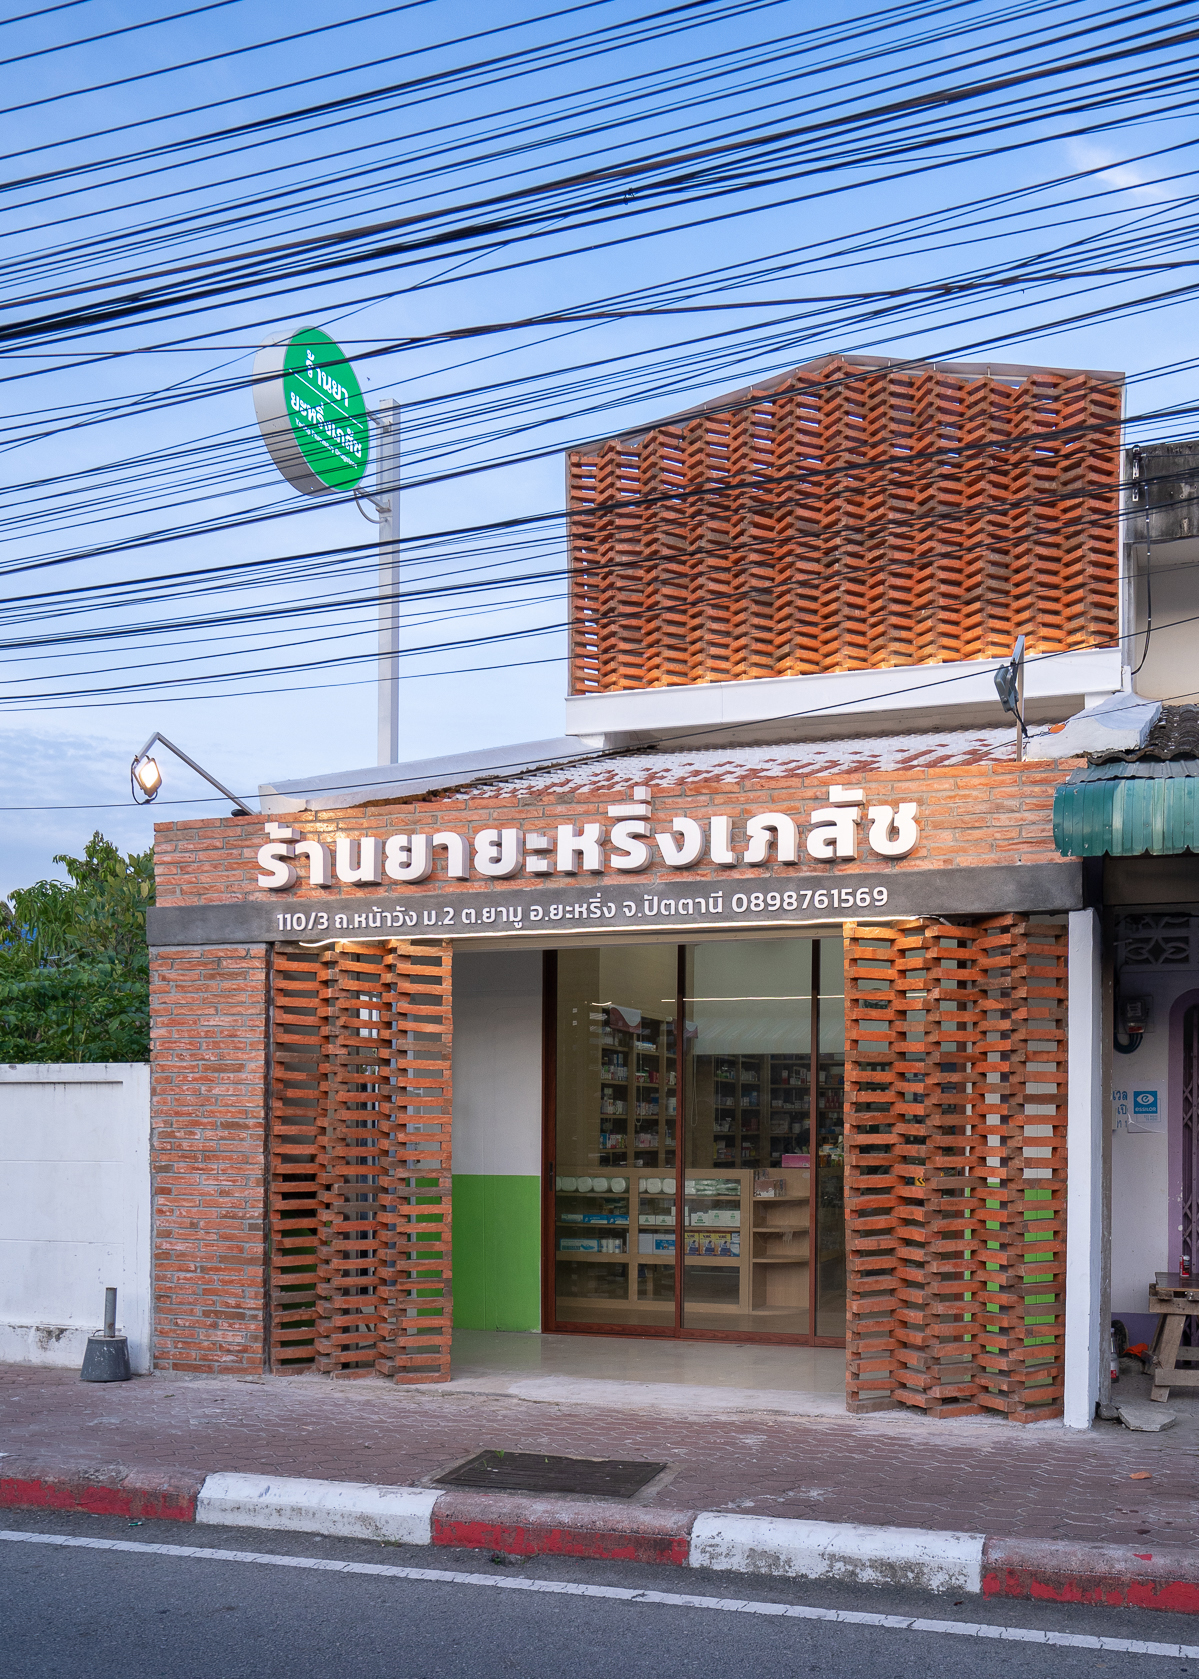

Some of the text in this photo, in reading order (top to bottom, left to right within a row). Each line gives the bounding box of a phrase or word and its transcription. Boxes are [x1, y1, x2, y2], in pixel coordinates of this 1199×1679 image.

[305, 349, 349, 407] ร้านยา
[257, 785, 920, 890] ร้านยายะหริ่งเภสัช
[276, 886, 889, 931] 110/3 ถ.หน้าวัง ม.2 ต.ยามู อ.ยะหริ่ง จ.ปัตตานี 0898761569
